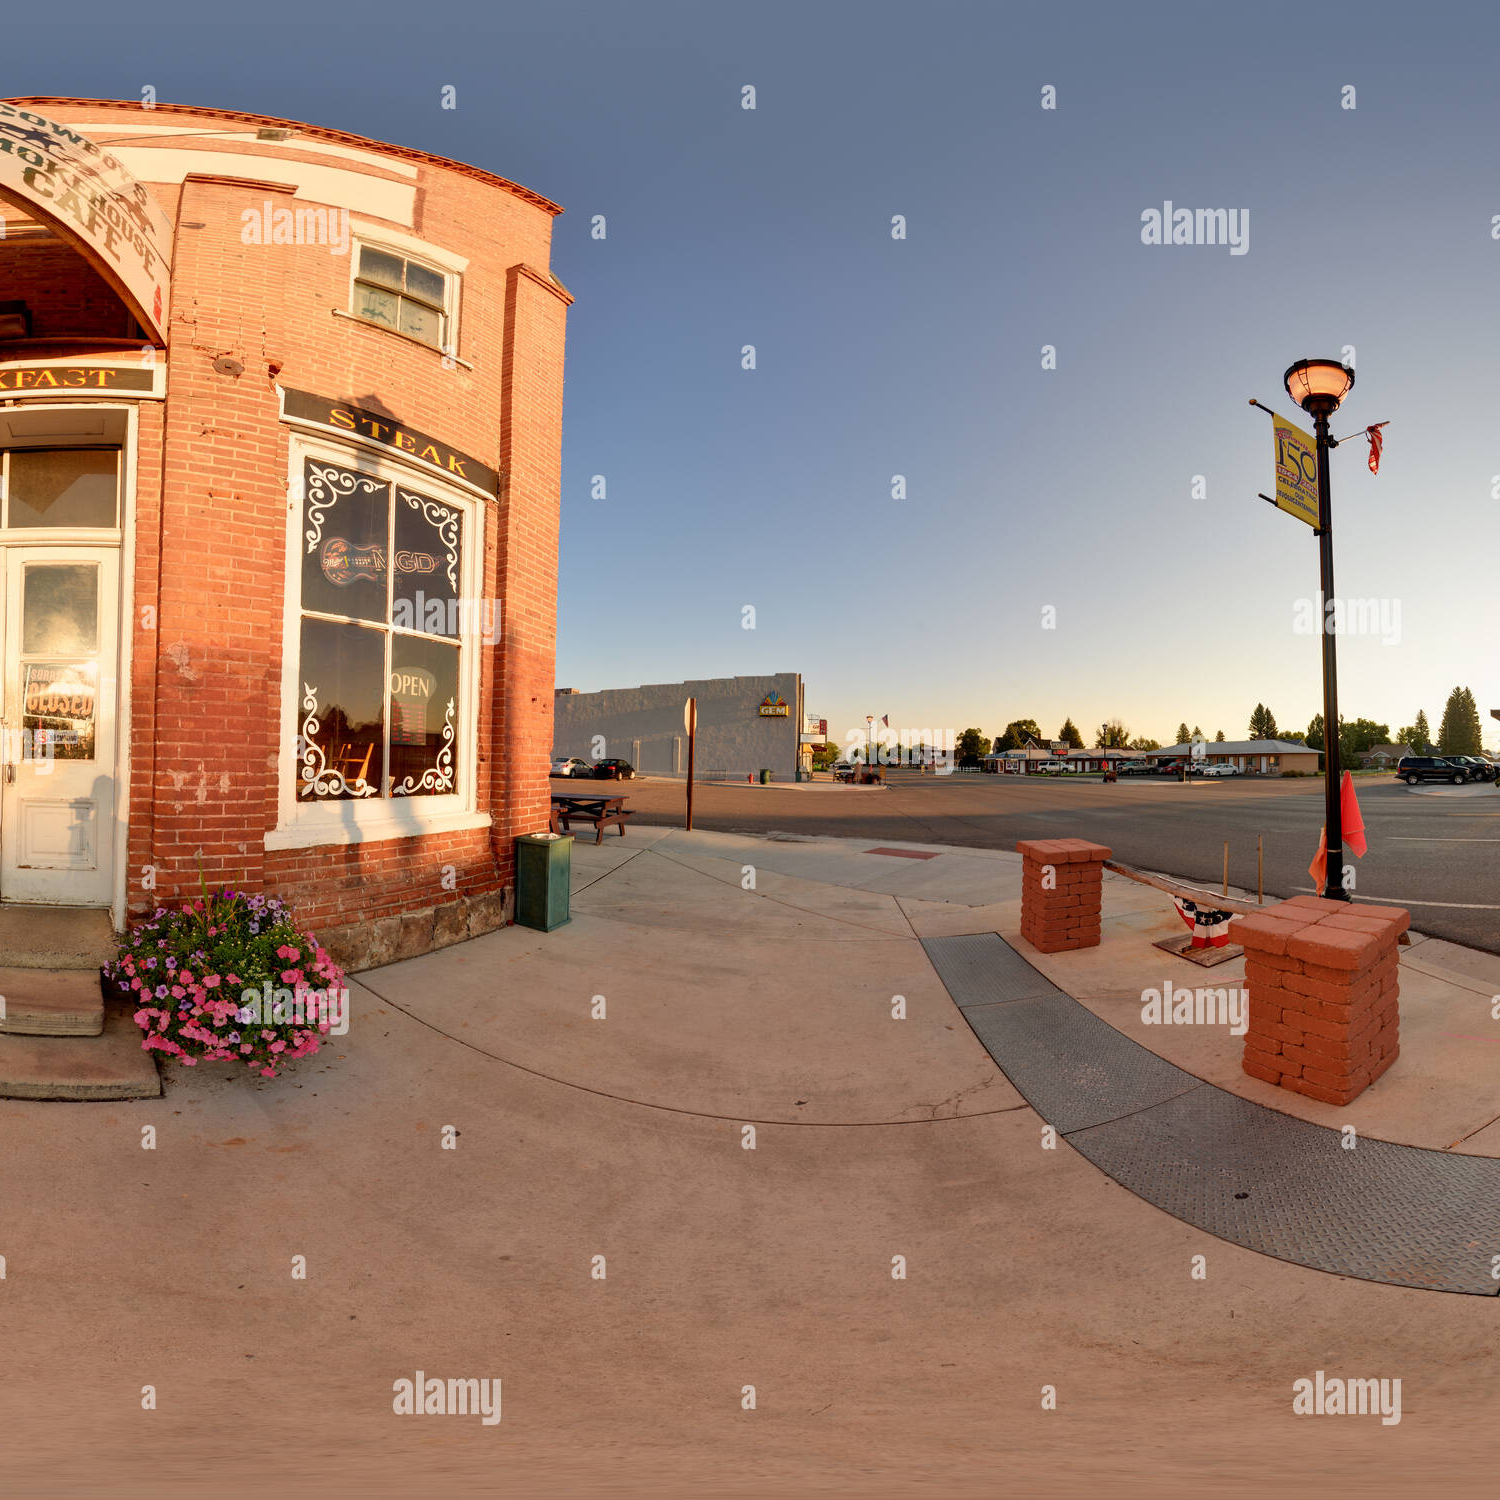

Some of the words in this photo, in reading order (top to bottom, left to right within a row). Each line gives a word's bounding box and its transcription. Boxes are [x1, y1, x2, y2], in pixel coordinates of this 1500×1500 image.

[22, 166, 122, 263] CAFE
[328, 408, 468, 479] STEAK
[1276, 437, 1317, 487] 150
[391, 672, 429, 697] OPEN
[761, 706, 786, 715] GEM
